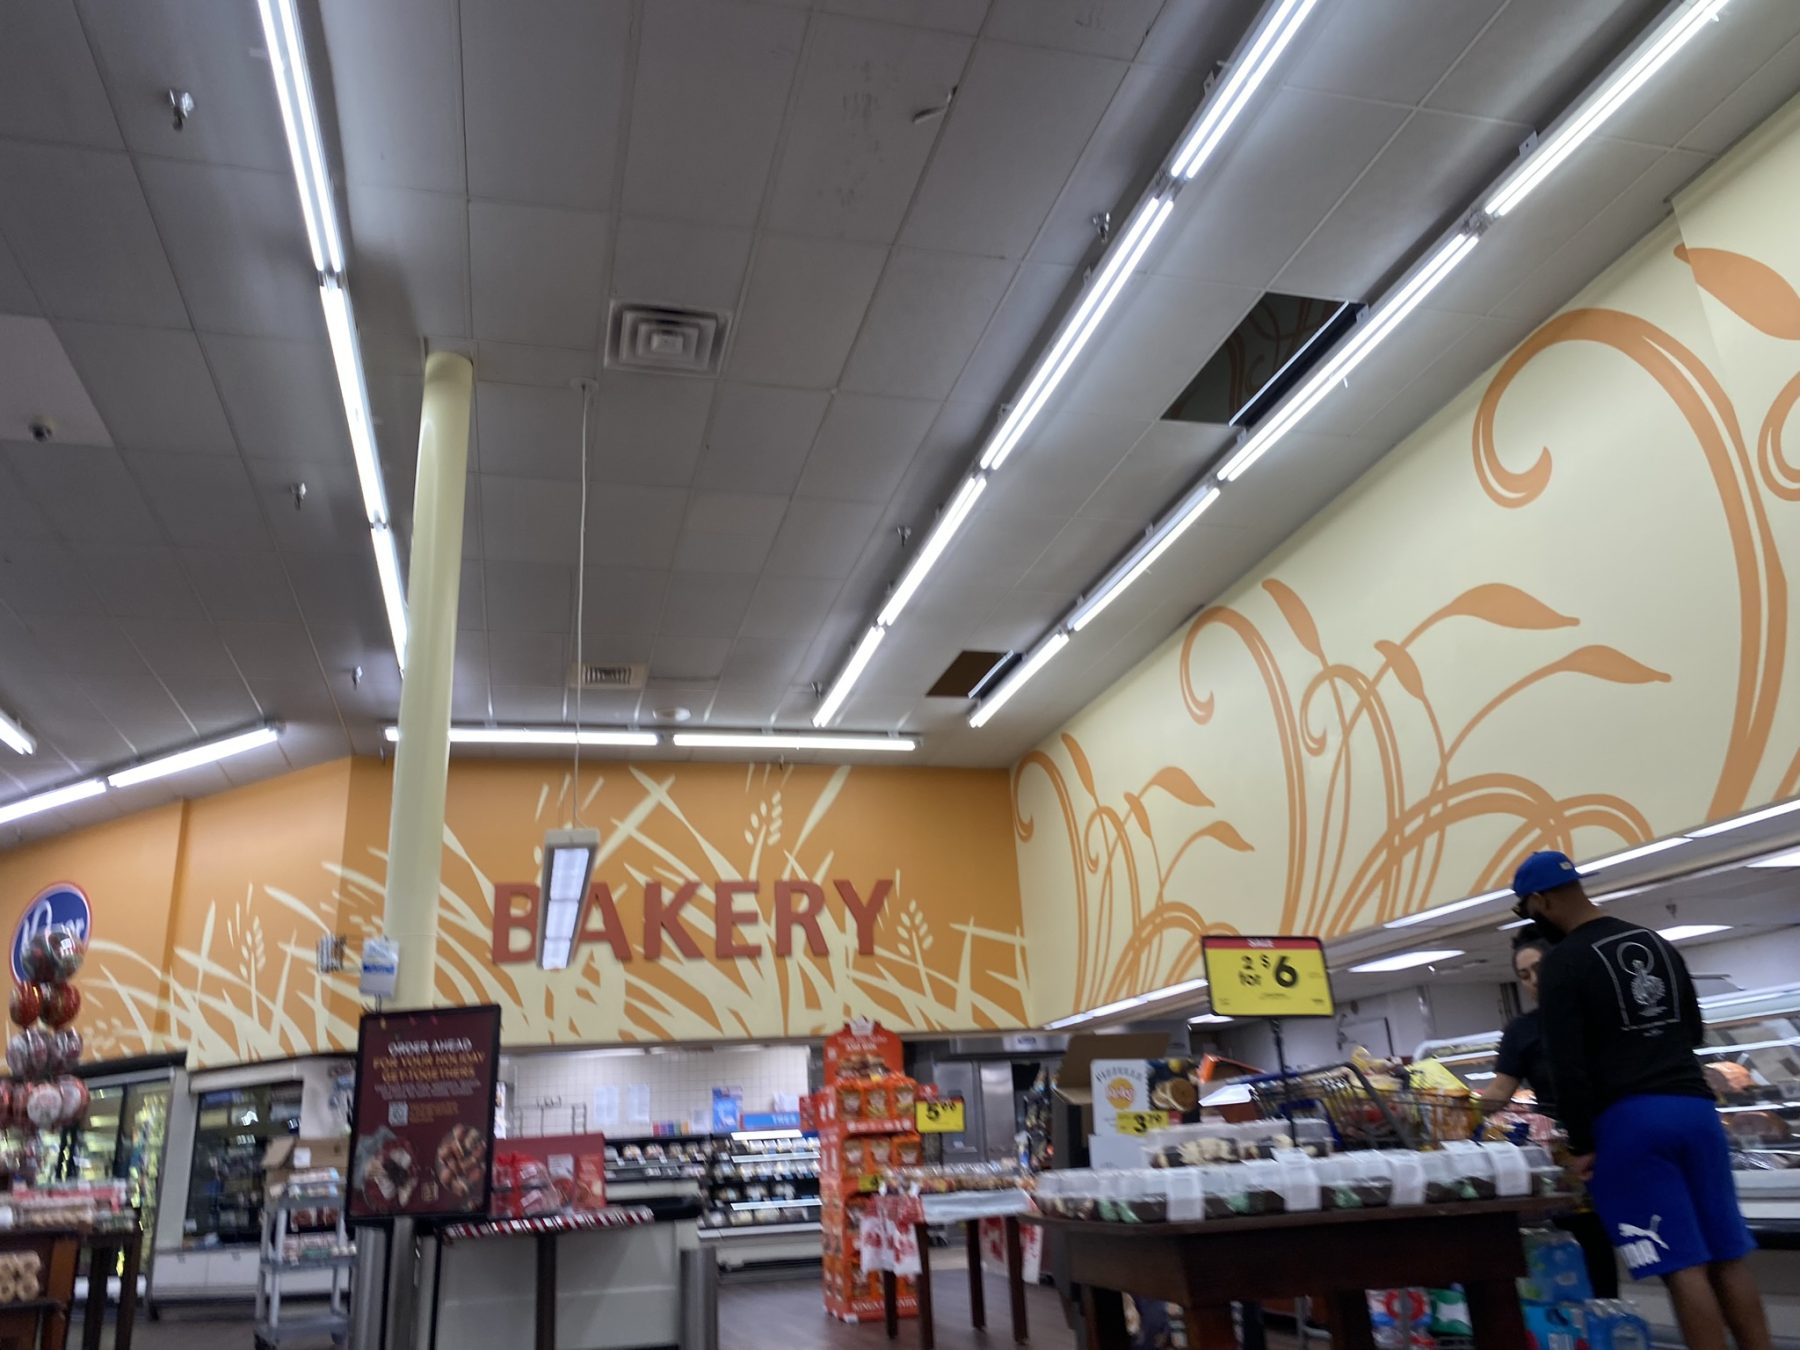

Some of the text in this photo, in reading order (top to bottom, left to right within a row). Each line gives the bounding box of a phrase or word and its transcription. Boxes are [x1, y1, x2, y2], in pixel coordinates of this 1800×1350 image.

[491, 878, 894, 966] BAKERY
[1241, 954, 1255, 971] 2
[387, 1037, 473, 1057] ORDER AHEAD
